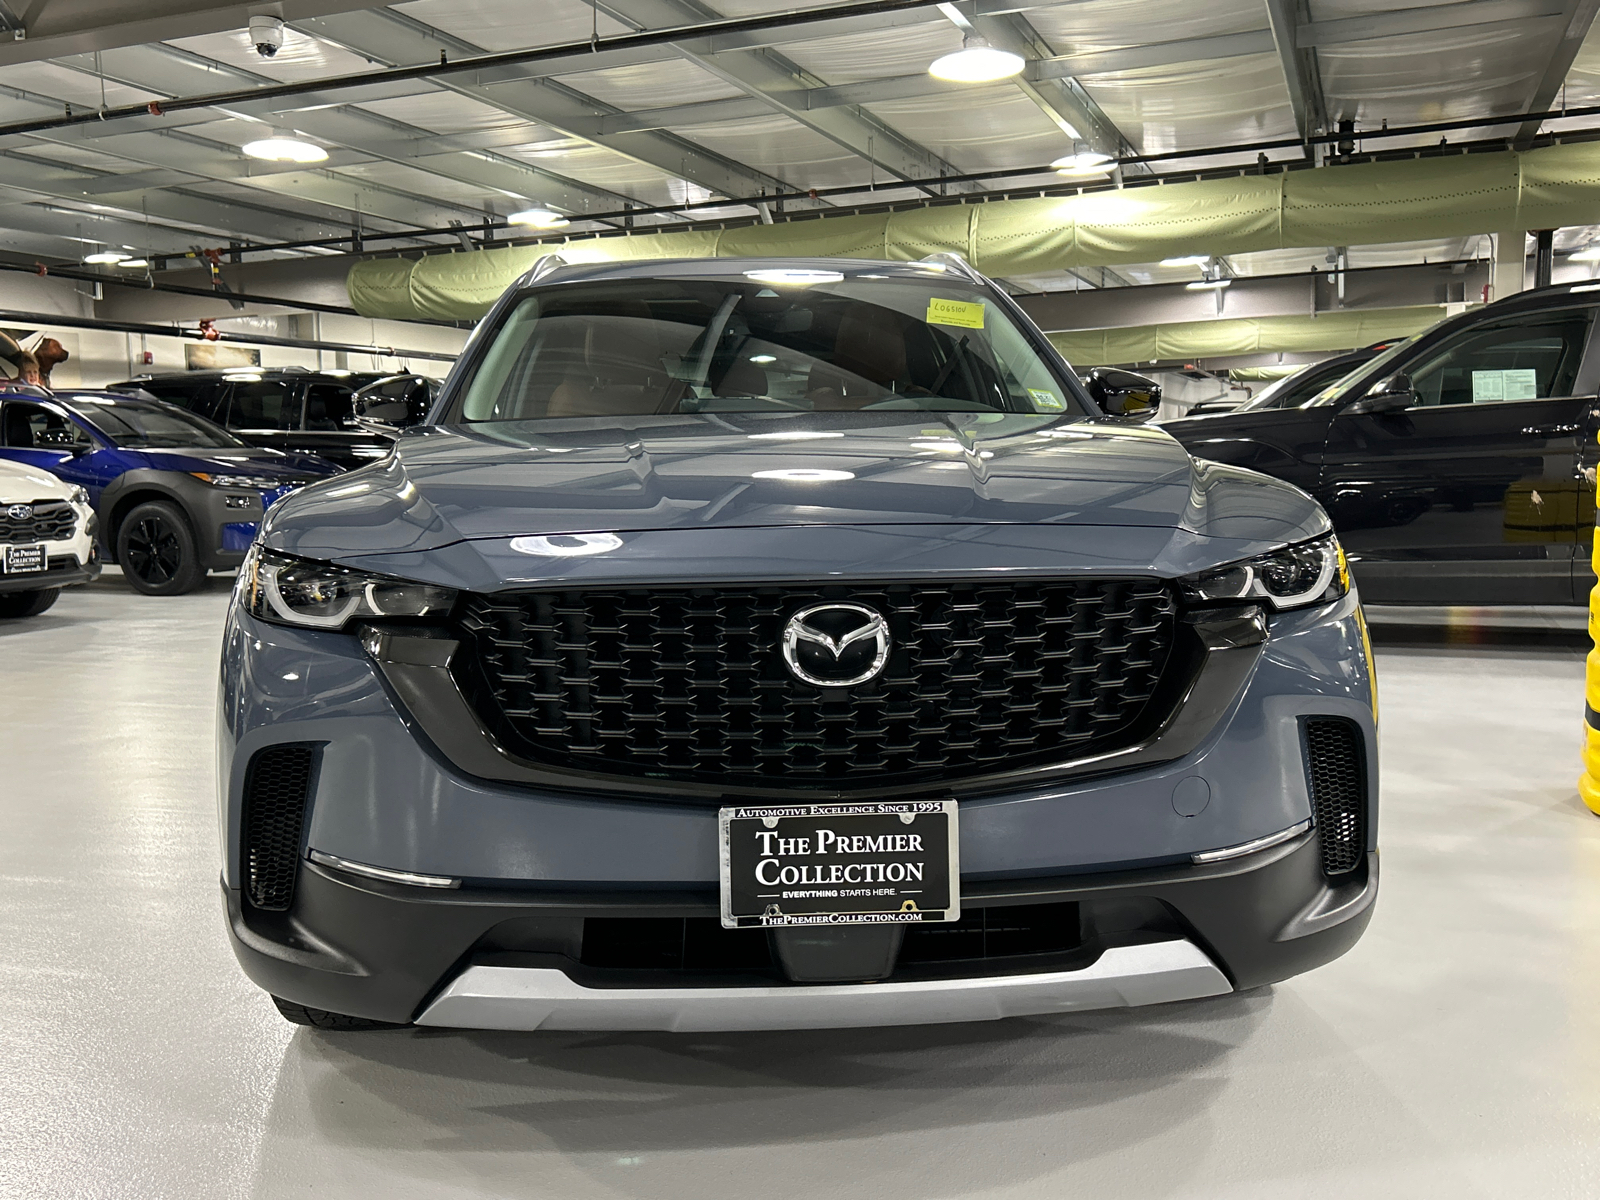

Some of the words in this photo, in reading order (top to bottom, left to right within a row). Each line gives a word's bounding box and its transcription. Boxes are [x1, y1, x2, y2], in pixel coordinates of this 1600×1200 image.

[737, 807, 808, 818] AUTOMOTIVE
[810, 805, 876, 816] EXCELLENCE
[877, 803, 909, 814] SINCE
[912, 802, 941, 813] 1995
[755, 830, 811, 857] THE
[815, 829, 925, 855] PREMIER
[755, 858, 925, 886] COLLECTION
[782, 889, 838, 899] EVERYTHING
[840, 888, 871, 897] STARTS
[872, 887, 898, 897] HERE.
[759, 911, 923, 926] THEPREMIERCOLLECTION.COM
